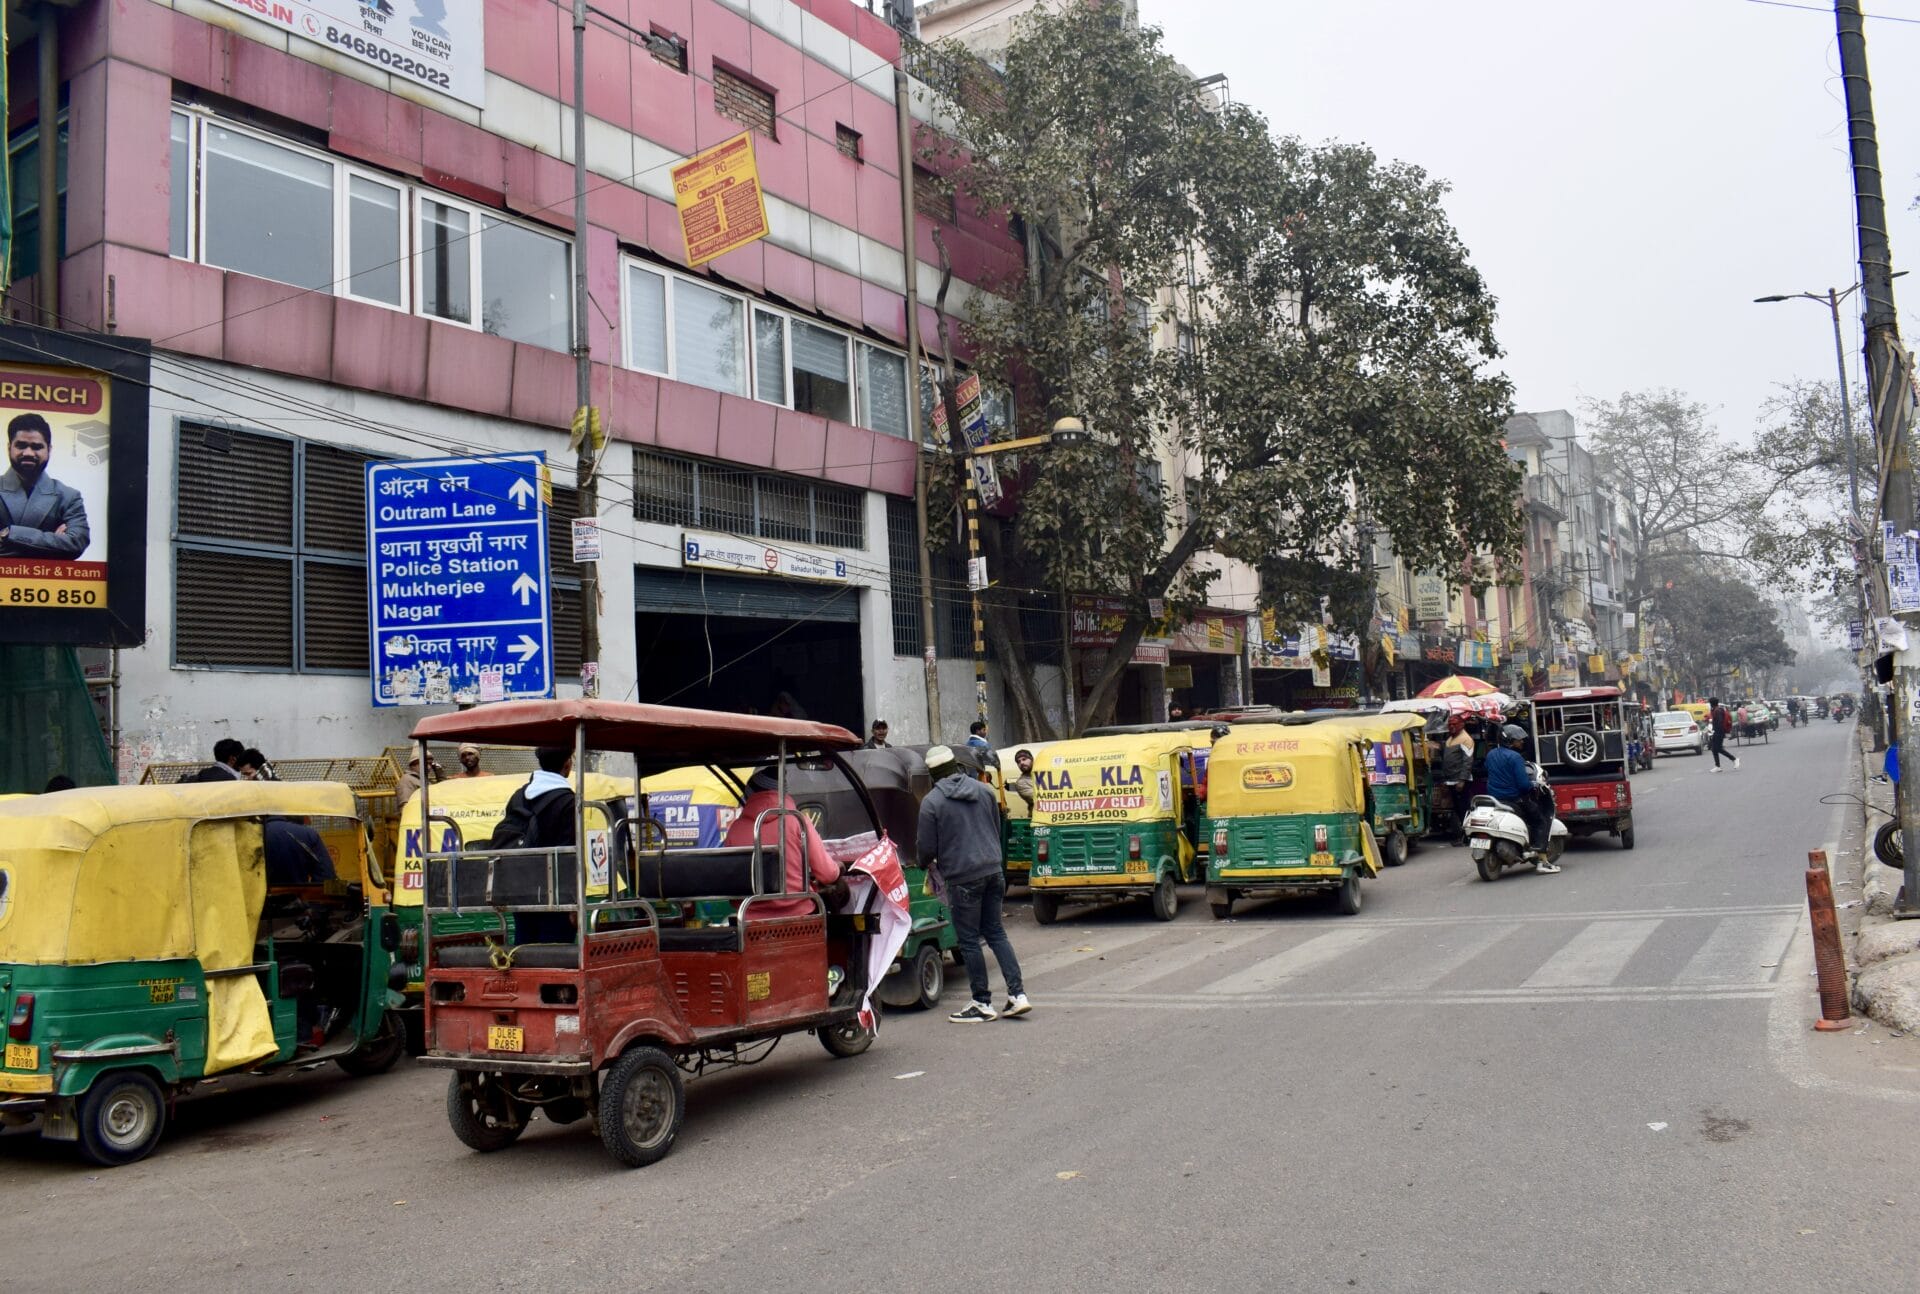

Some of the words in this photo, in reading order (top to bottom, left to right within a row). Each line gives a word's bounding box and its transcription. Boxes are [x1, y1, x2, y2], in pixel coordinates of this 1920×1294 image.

[411, 28, 430, 45] YOU
[432, 34, 451, 52] CAN
[326, 26, 450, 89] 8468022022
[411, 39, 424, 50] BE
[425, 43, 450, 60] NEXT
[714, 161, 727, 176] PG
[379, 474, 429, 498] ऑट्रम
[439, 472, 470, 493] लेन
[380, 504, 446, 521] Outram
[453, 502, 496, 517] Lane
[381, 540, 421, 558] थाना
[426, 532, 483, 561] मुखर्जी
[488, 535, 528, 551] नगर
[689, 545, 698, 559] 2
[33, 565, 51, 577] Sir
[54, 567, 64, 577] &
[66, 567, 101, 577] Team
[382, 562, 442, 577] Police
[449, 557, 518, 575] Station
[791, 564, 811, 574] Bahadur
[813, 566, 828, 576] Nagar
[837, 562, 845, 576] 2
[10, 588, 50, 604] 850
[57, 590, 96, 605] 850
[383, 580, 485, 599] Mukherjee
[383, 604, 442, 622] Nagar
[456, 636, 498, 653] नगर
[1236, 743, 1248, 756] हर
[1253, 742, 1265, 753] हर
[1267, 739, 1298, 752] महादेव
[1385, 744, 1404, 759] PLA
[1033, 770, 1073, 791] KLA
[1101, 765, 1143, 787] KLA
[1068, 790, 1093, 798] LAWZ
[1097, 787, 1144, 796] ACADEMY
[1039, 799, 1096, 812] JUDICIARY
[1111, 796, 1141, 808] CLAT
[450, 810, 475, 818] KARAT
[665, 806, 700, 822] PLA
[1051, 810, 1128, 823] 8929514009
[406, 828, 456, 858] KA
[495, 1039, 519, 1050] R4851
